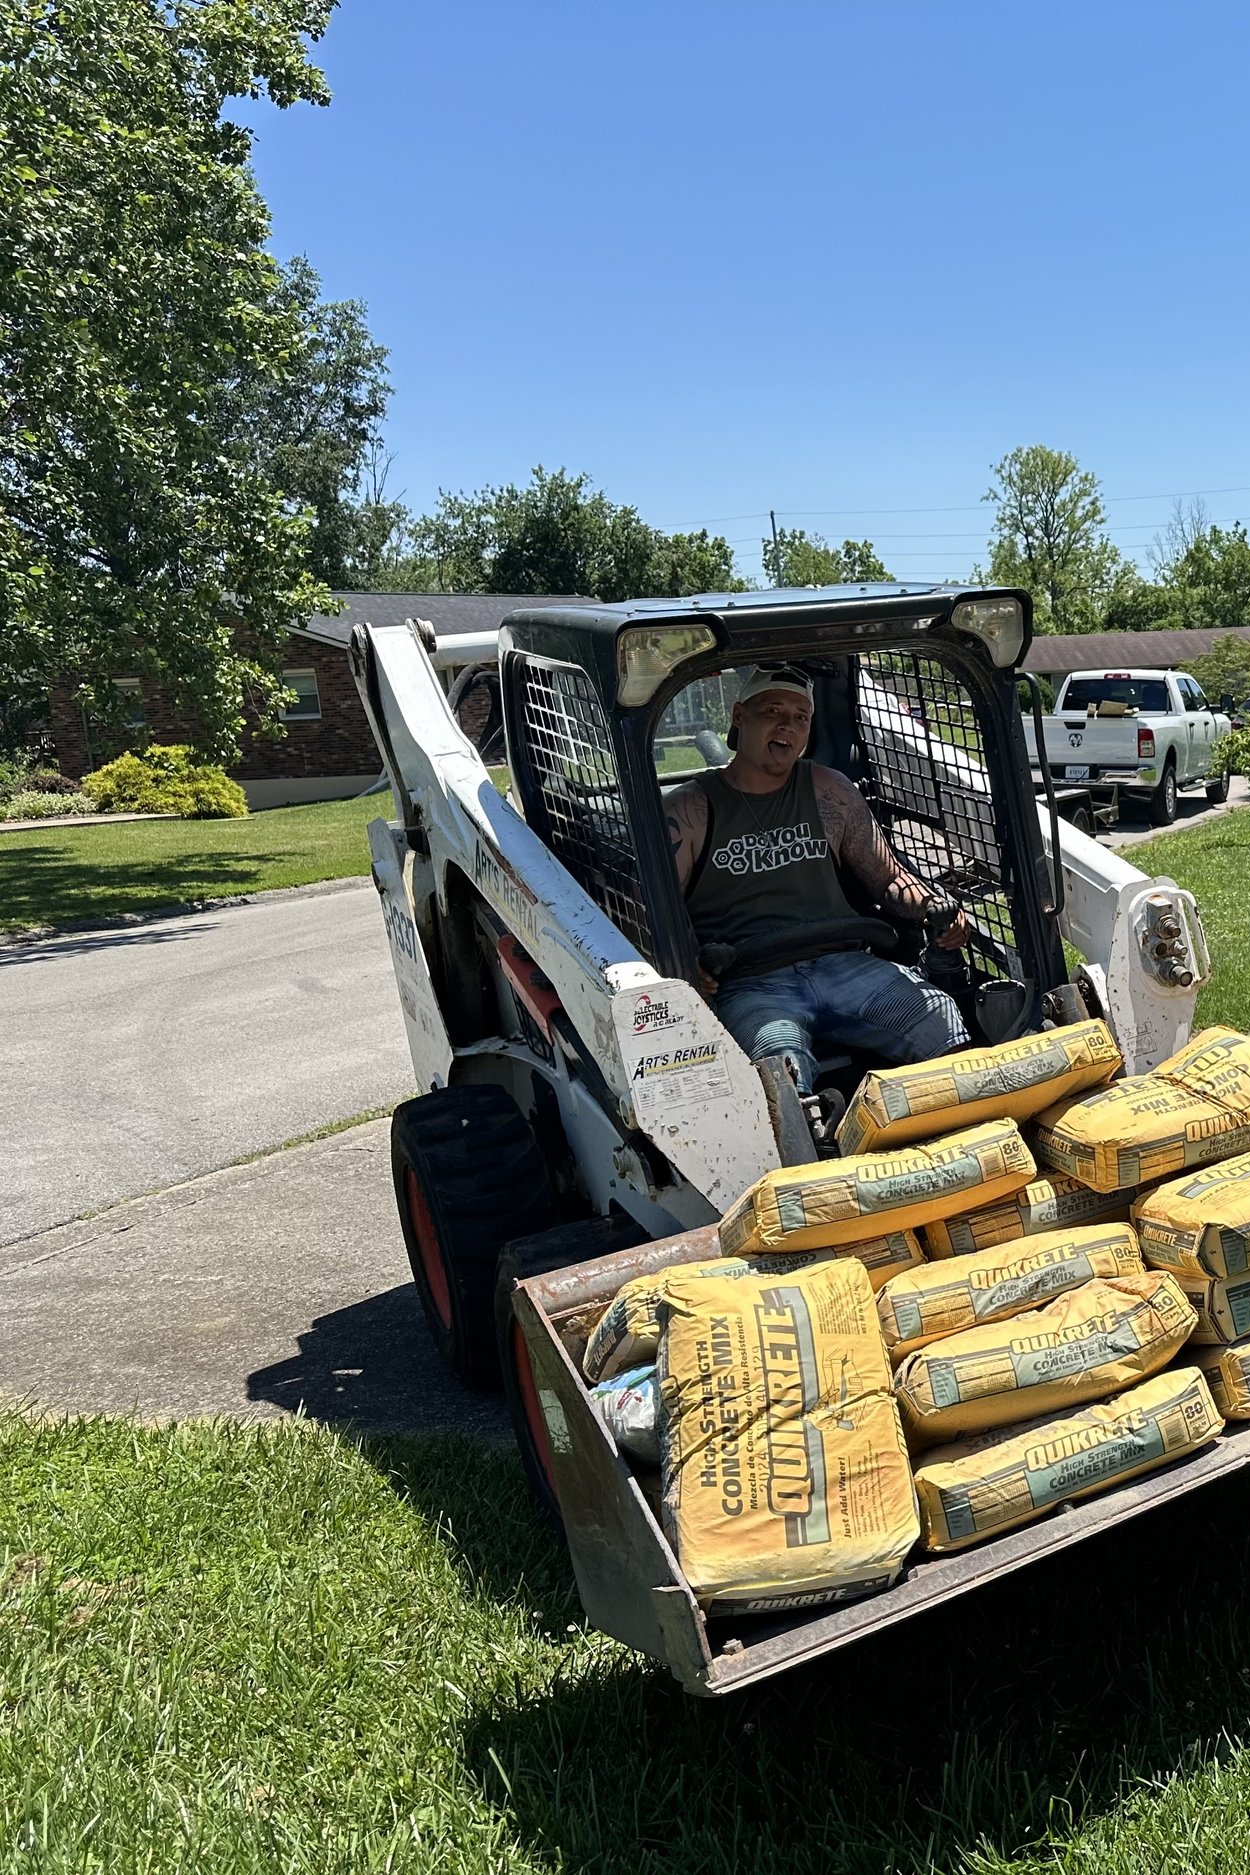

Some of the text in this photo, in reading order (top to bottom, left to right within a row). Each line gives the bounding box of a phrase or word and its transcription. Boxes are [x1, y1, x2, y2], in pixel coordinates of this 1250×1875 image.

[503, 873, 541, 939] RENTAL
[633, 1010, 669, 1026] JOYSTICKS
[1086, 1035, 1105, 1047] 80
[633, 1057, 670, 1081] ART'S
[674, 1044, 717, 1063] RENTAL
[952, 1037, 1055, 1075] QUIKRETE
[1130, 1099, 1171, 1116] MIX
[1154, 1100, 1208, 1117] TRENGTH
[1002, 1141, 1020, 1156] 80
[1199, 1137, 1246, 1158] CONCRETE
[856, 1144, 968, 1184] QUIKRETE
[878, 1179, 940, 1201] CONCRETE
[888, 1176, 914, 1189] HIGH
[1038, 1192, 1120, 1223] CONCRETE MIX
[1047, 1198, 1068, 1210] HIGH
[1142, 1224, 1177, 1247] QUIKRETE
[968, 1242, 1078, 1290] QUIKRETE
[1115, 1246, 1131, 1259] 80
[989, 1270, 1076, 1305] CONCRETE MIX
[999, 1265, 1066, 1293] HIGH STRENGTH
[1153, 1296, 1174, 1312] 80
[1010, 1309, 1120, 1355] QUIKRETE
[1032, 1349, 1095, 1372] CONCRETE
[1044, 1335, 1108, 1360] HIGH STRENGTH
[698, 1340, 717, 1488] HIGH STRENGTH
[710, 1316, 743, 1517] CONCRETE MIX
[736, 1316, 758, 1510] Mezcla de Concreto de Alta Resistencia
[753, 1304, 814, 1518] QUIKRETE
[1185, 1401, 1203, 1419] 80
[1026, 1408, 1149, 1471] QUIKRETE
[1049, 1457, 1119, 1489] CONCRETE
[1120, 1443, 1146, 1464] MIX
[1059, 1439, 1136, 1475] HIGH STRENGTH
[838, 1456, 852, 1539] Just Add Water!
[747, 1589, 847, 1610] QUIKRETE
